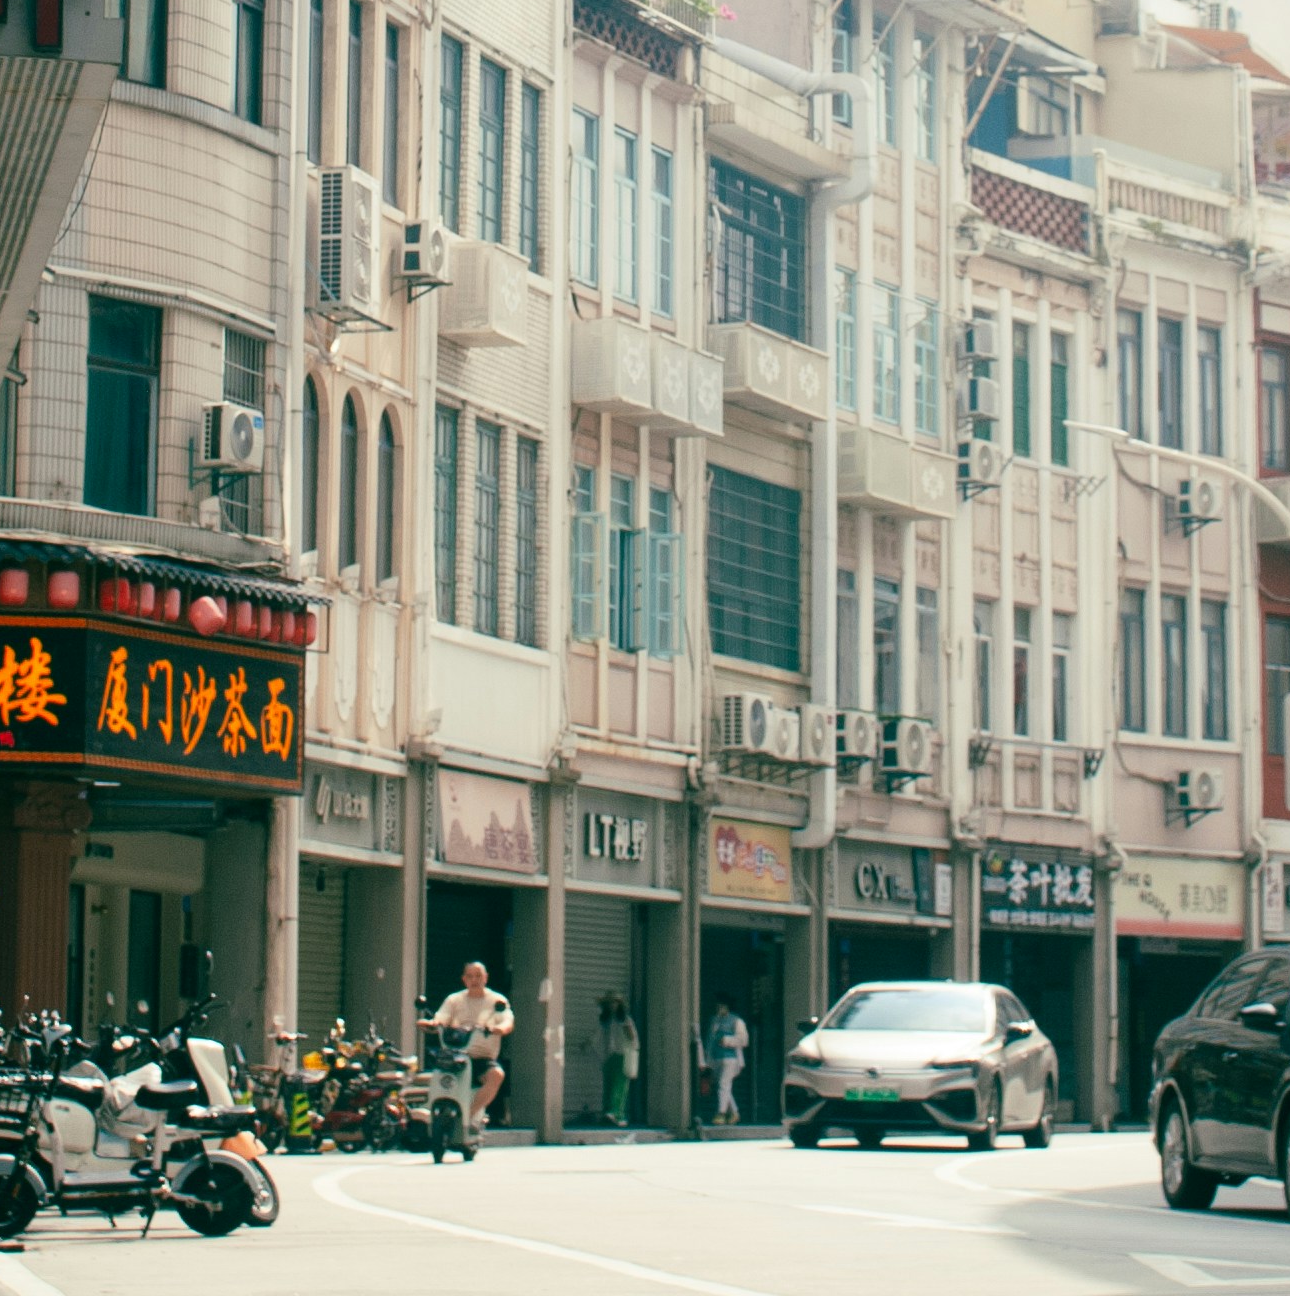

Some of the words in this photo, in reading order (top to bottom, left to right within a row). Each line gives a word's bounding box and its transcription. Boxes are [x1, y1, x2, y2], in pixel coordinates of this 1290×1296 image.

[97, 646, 294, 762] 厦门沙茶面
